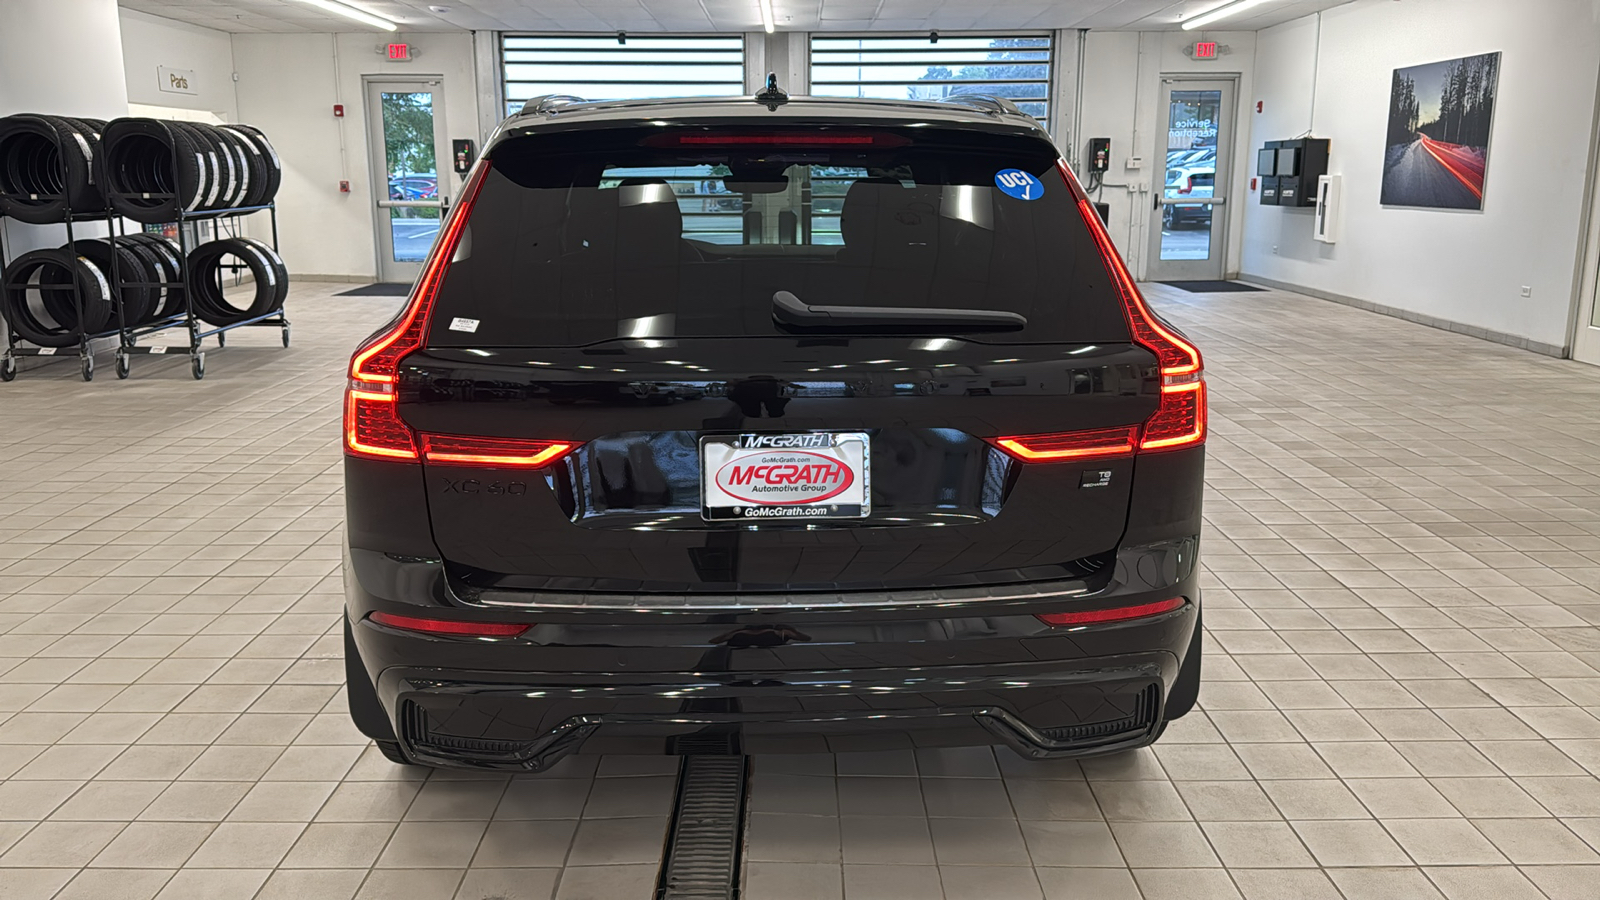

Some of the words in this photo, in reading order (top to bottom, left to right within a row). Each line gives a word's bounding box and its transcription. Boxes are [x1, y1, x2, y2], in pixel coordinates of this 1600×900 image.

[388, 43, 407, 59] EXIT
[1196, 42, 1215, 57] EXIT
[170, 73, 188, 90] Parts
[997, 170, 1034, 188] UCI
[761, 456, 811, 464] GoMcGrath.com
[751, 485, 799, 493] Automotive
[800, 484, 827, 493] Group
[744, 506, 828, 517] GoMcGrath.com
